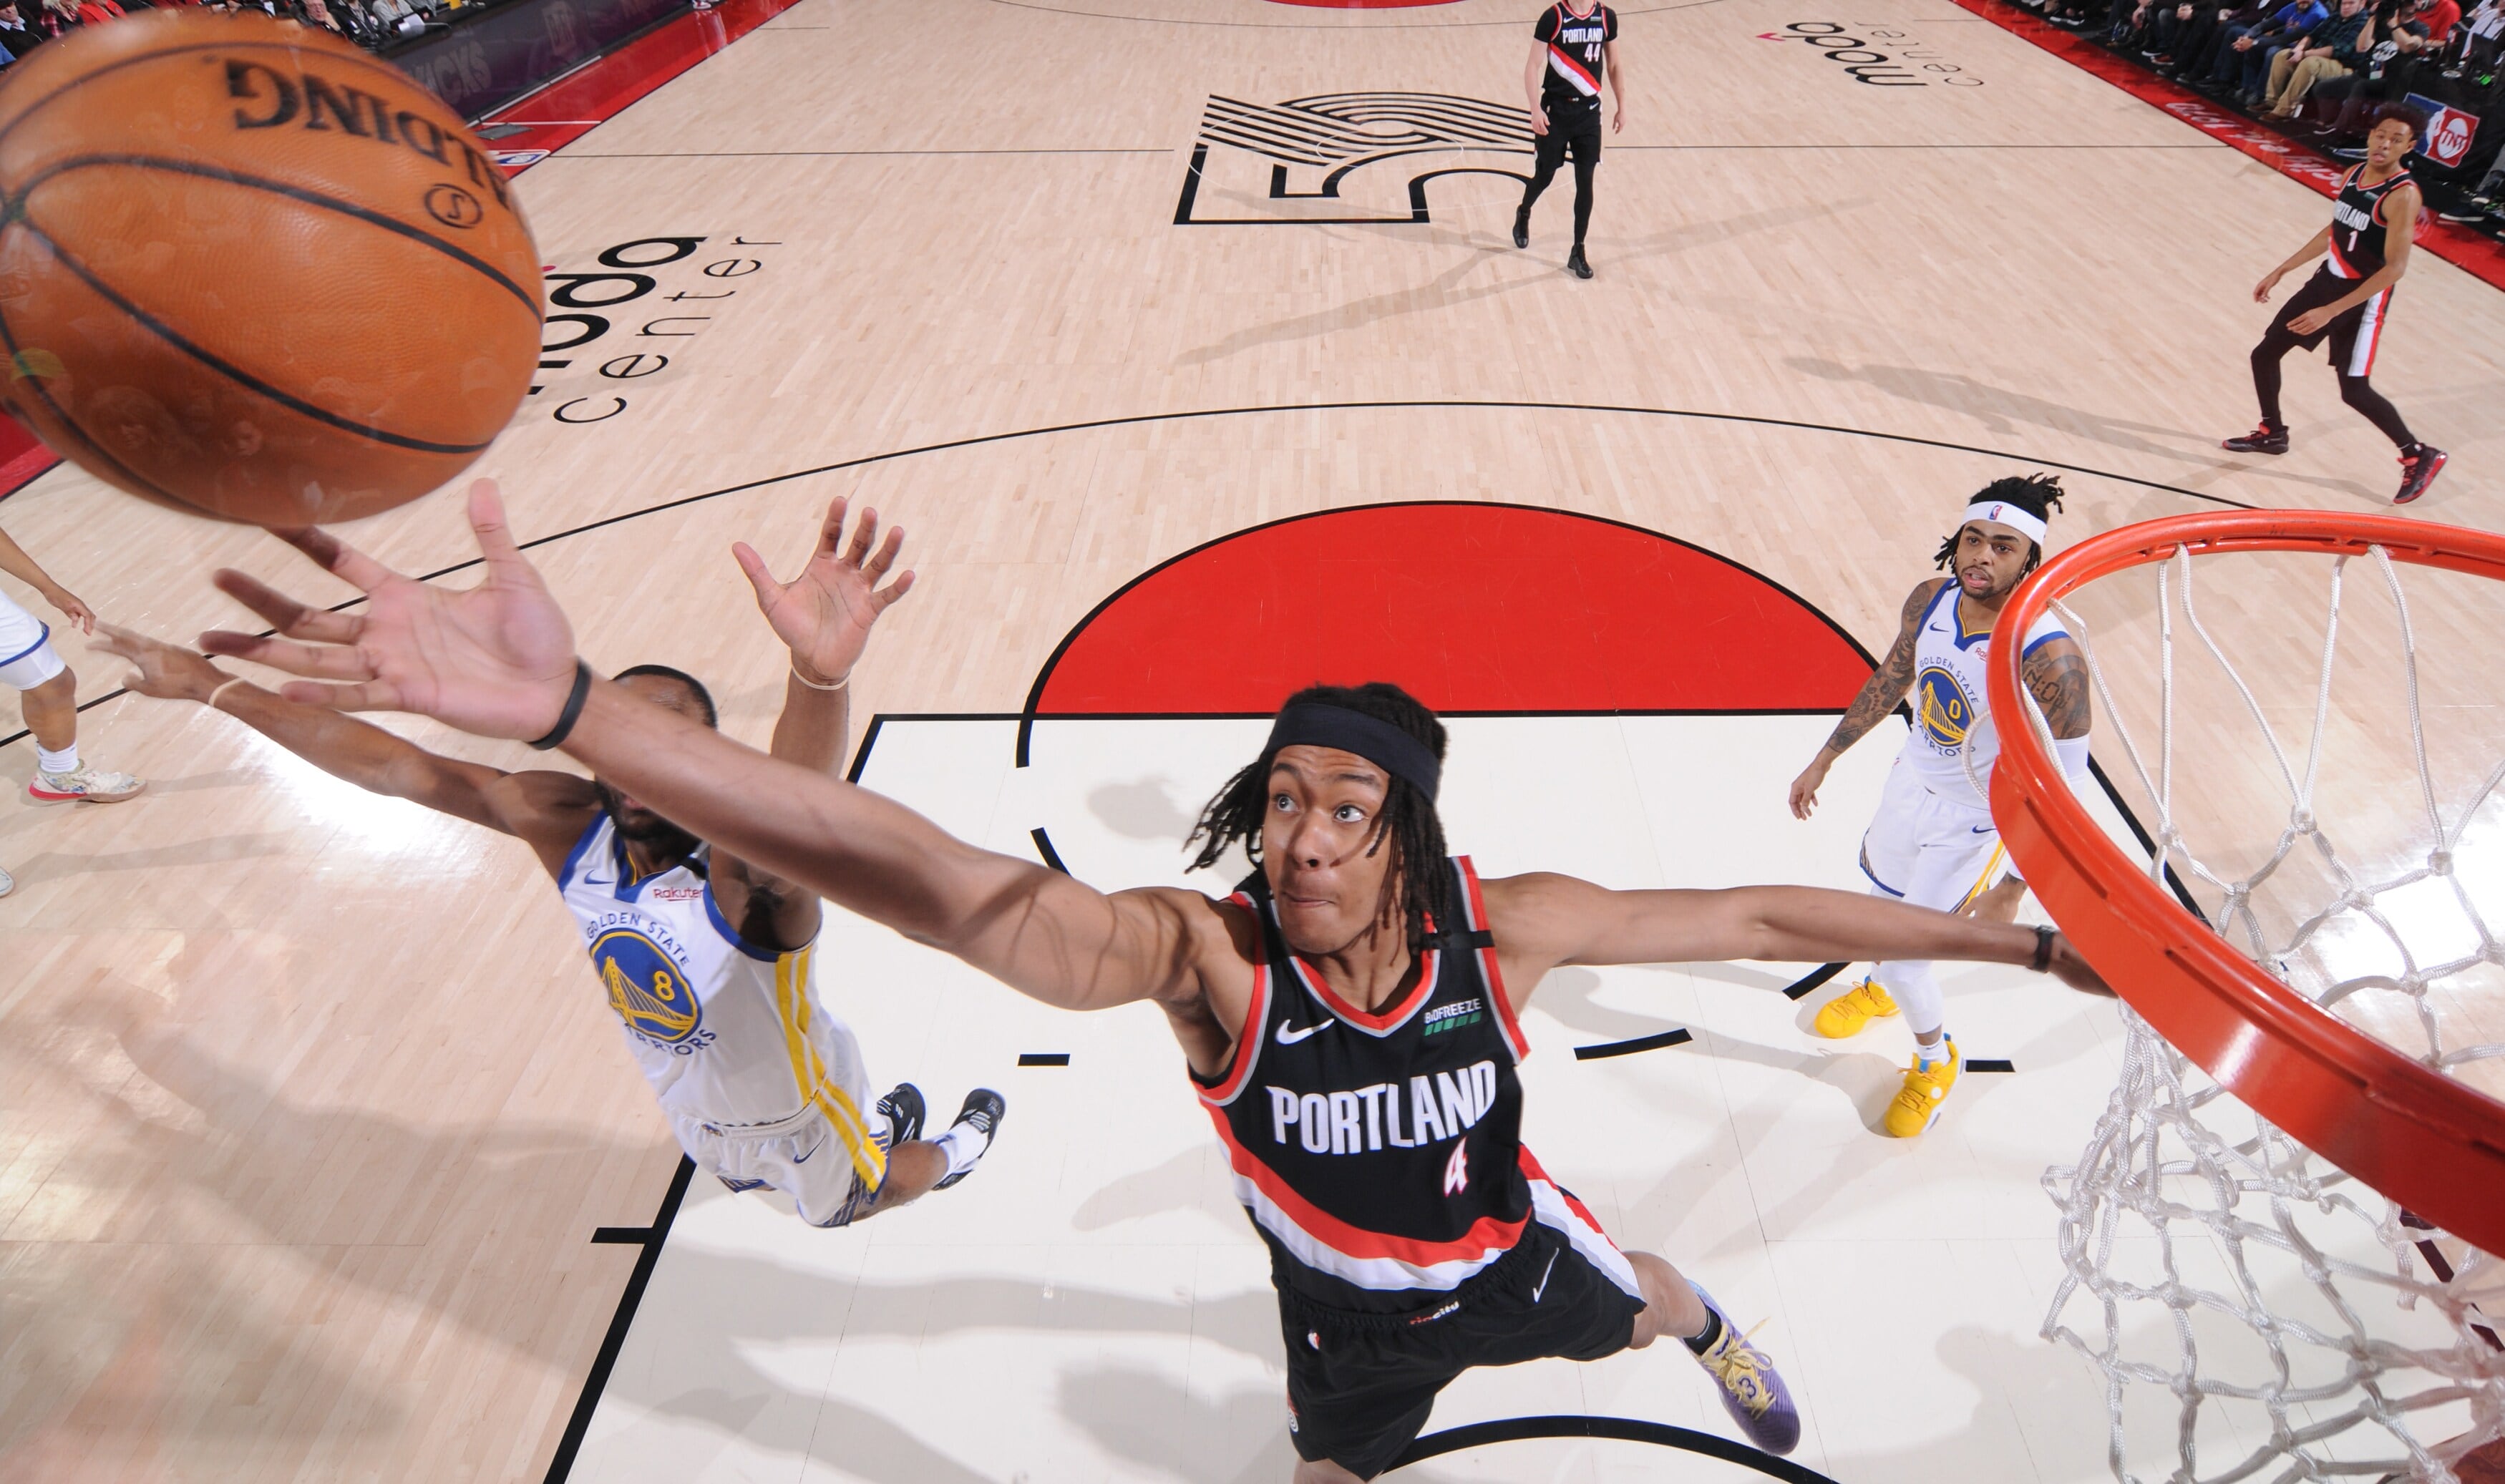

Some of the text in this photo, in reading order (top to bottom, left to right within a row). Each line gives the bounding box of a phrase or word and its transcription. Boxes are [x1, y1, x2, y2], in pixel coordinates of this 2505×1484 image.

[1562, 27, 1603, 44] PORTLAND
[1584, 43, 1602, 62] 44
[1781, 21, 1928, 86] moda
[1854, 21, 1985, 87] center
[225, 59, 510, 210] LDING
[2334, 200, 2371, 232] RTLAND
[2347, 230, 2358, 252] 1
[527, 236, 709, 396] oda
[553, 235, 783, 424] center
[1920, 656, 1980, 704] GOLDEN STATE
[1949, 698, 1962, 720] 0
[586, 912, 691, 968] GOLDEN STATE
[653, 970, 676, 1002] 8
[624, 1022, 716, 1058] RRIORS
[1265, 1060, 1497, 1154] PORTLAND
[1444, 1136, 1469, 1197] 4
